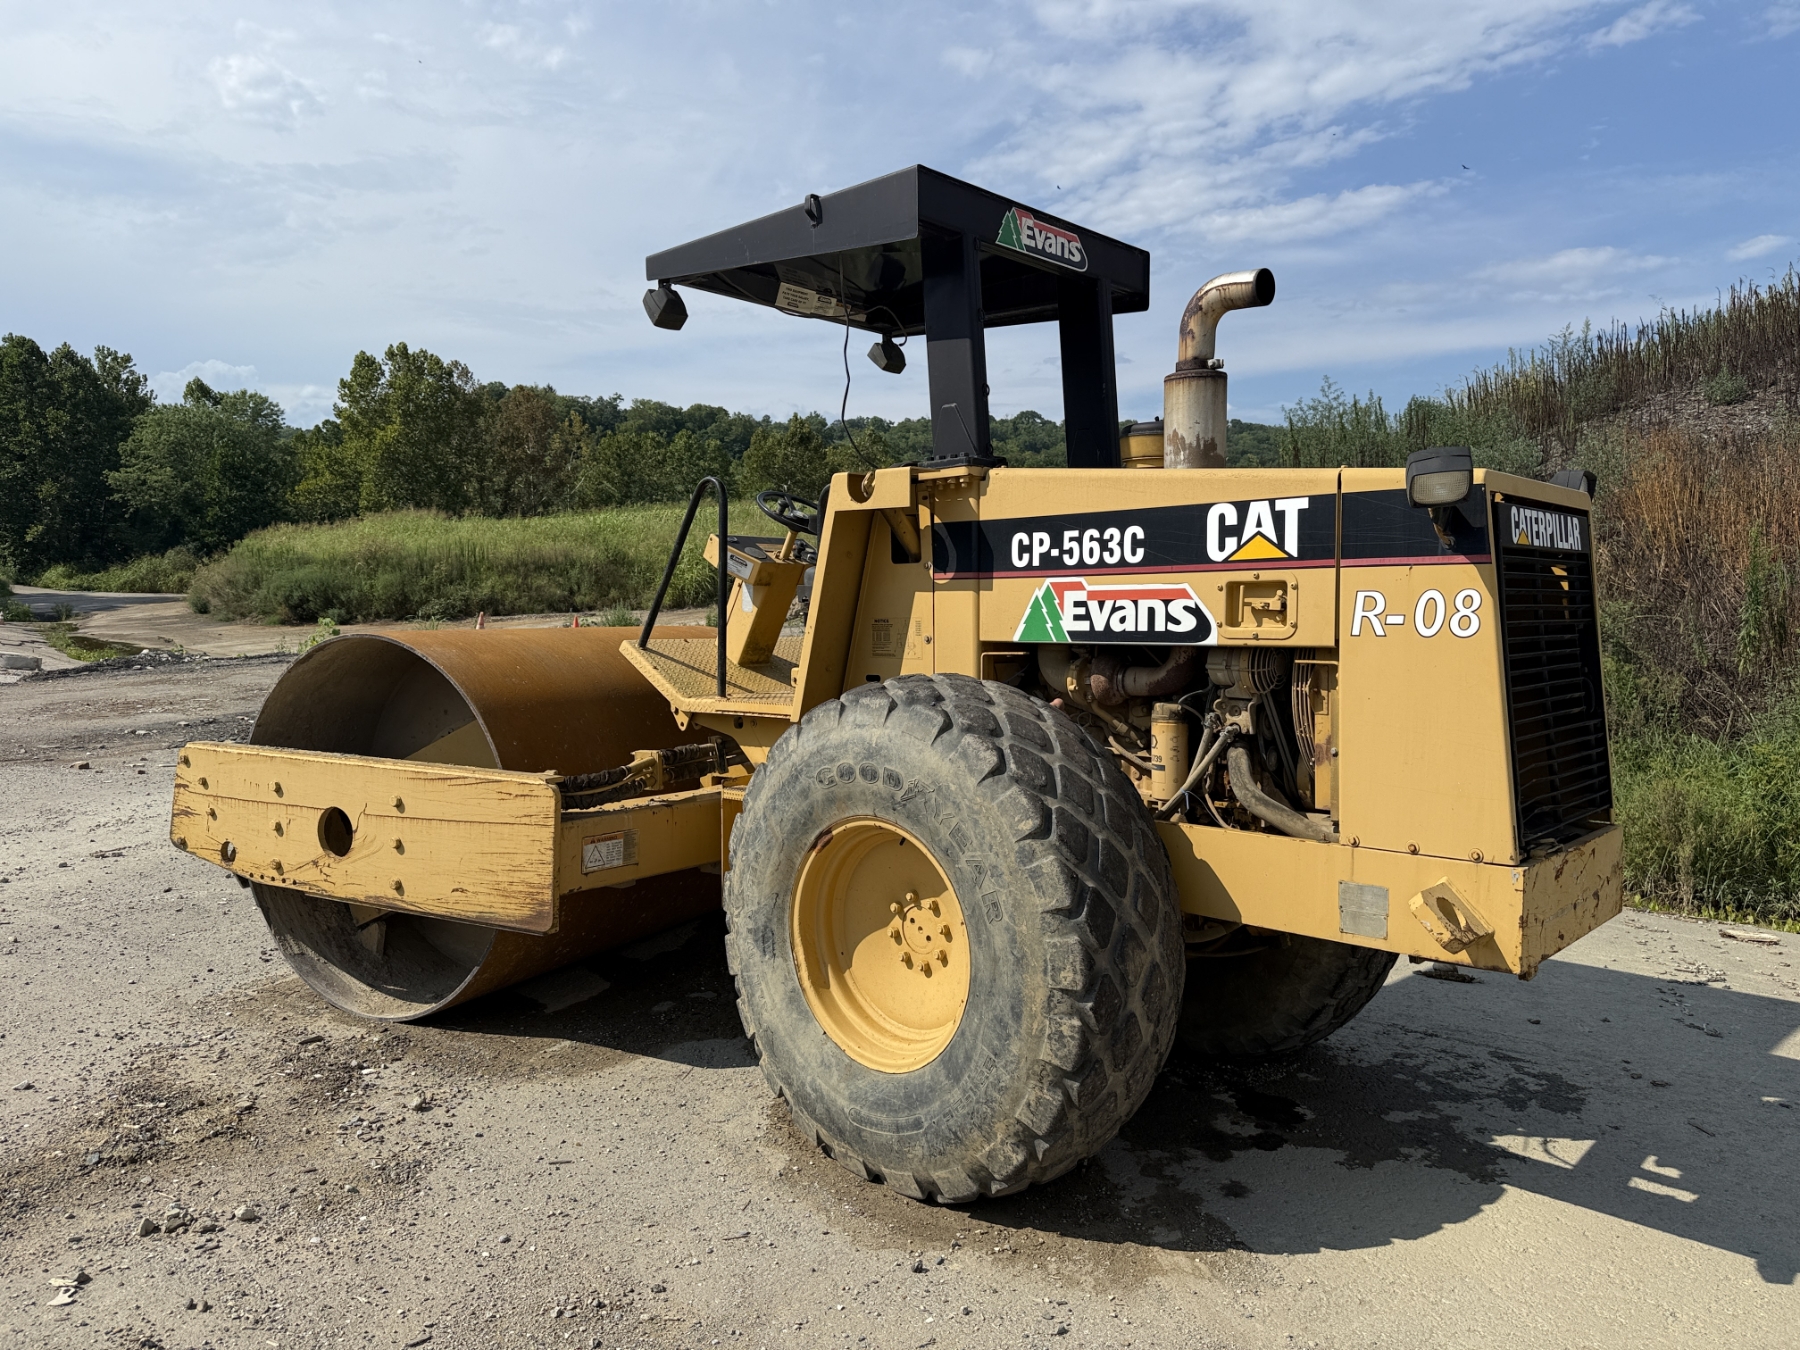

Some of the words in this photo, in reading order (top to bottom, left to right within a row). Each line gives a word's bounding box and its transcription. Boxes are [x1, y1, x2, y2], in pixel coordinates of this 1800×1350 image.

[1021, 216, 1082, 262] Evans
[1011, 525, 1145, 568] CP-563C
[1206, 497, 1309, 562] CAT
[1511, 506, 1582, 551] CATERPILLAR
[1063, 590, 1198, 633] Evans
[1350, 588, 1483, 638] R-08
[815, 762, 1003, 925] GOODYEAR
